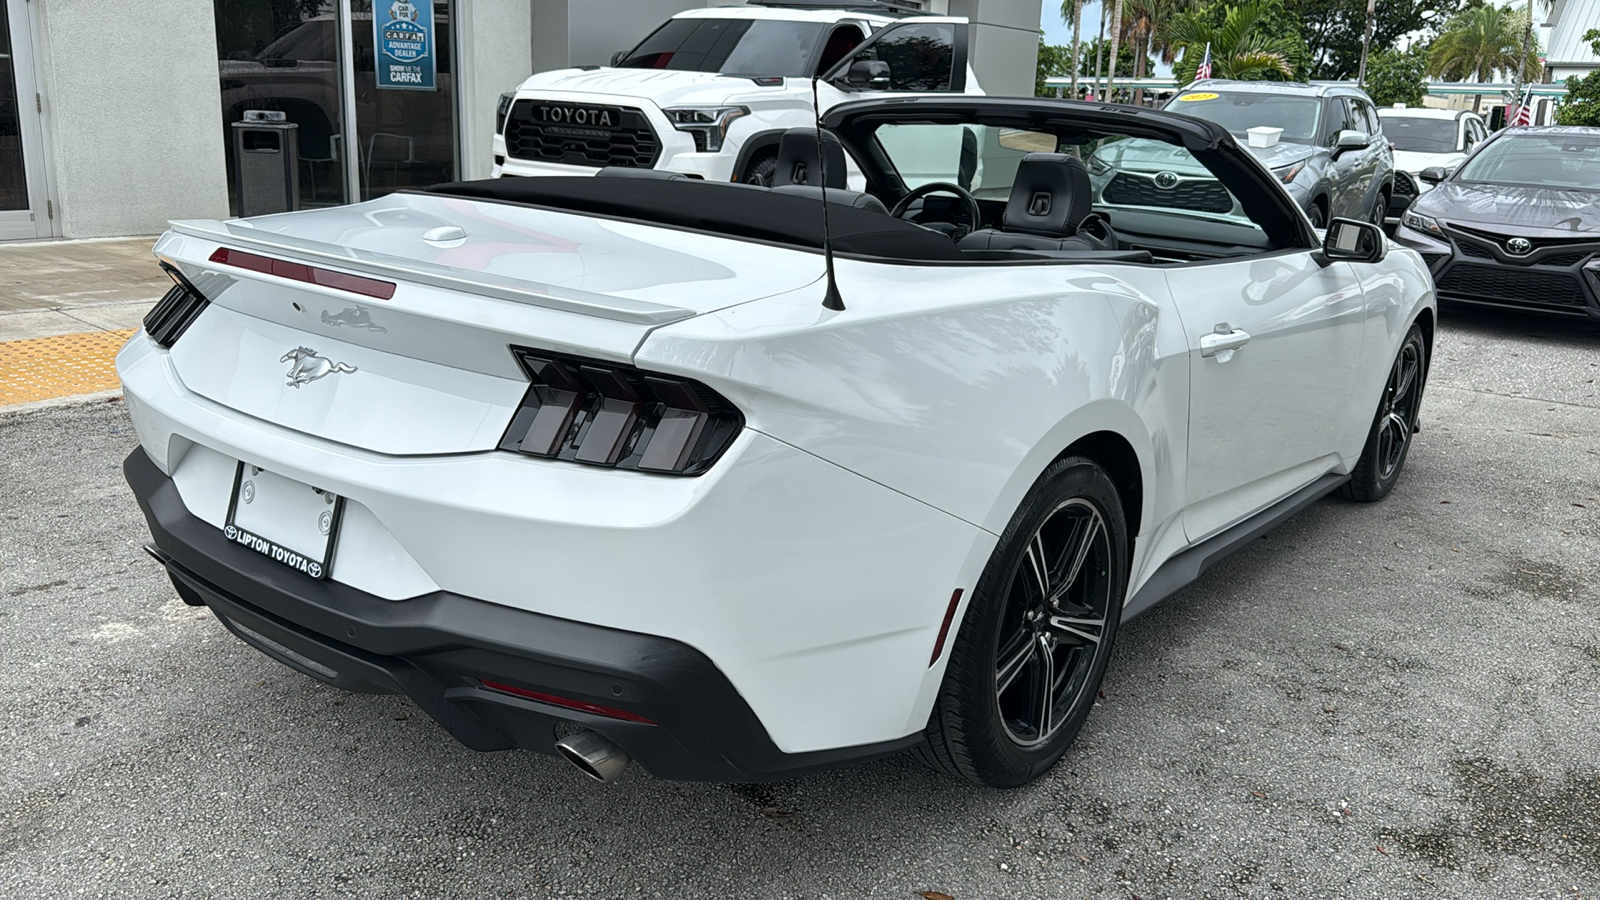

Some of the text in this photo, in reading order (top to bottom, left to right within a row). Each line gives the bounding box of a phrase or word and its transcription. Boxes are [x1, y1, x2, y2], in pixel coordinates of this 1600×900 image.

[385, 31, 424, 42] CARFAX
[389, 41, 422, 50] ADVANTAGE
[390, 72, 422, 83] CARFAX
[540, 106, 611, 126] TOYOTA
[236, 531, 308, 573] LIPTON TOYOTA
